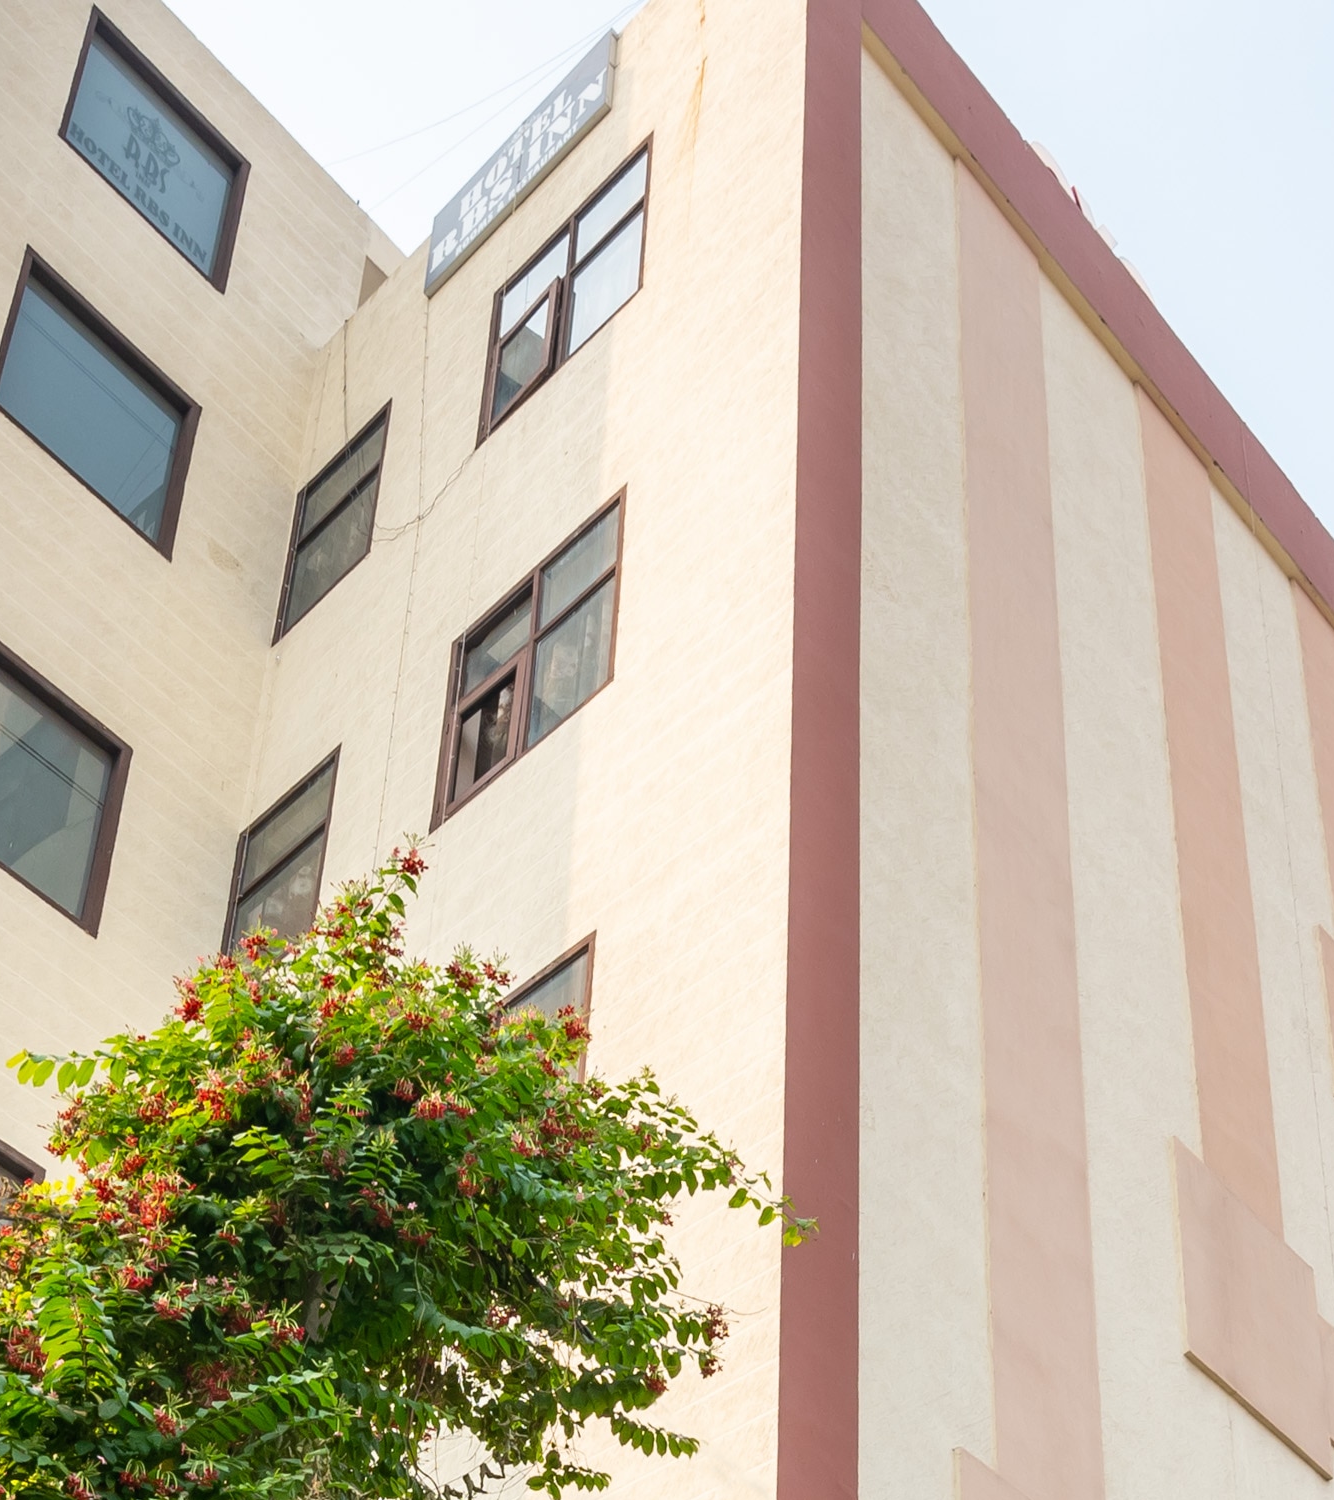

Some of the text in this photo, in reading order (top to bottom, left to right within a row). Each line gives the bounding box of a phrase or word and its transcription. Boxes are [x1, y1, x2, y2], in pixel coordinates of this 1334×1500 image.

[68, 120, 208, 264] HOTEL RBS INN
[430, 67, 609, 274] RBS INN
[458, 88, 573, 221] HOTEL
